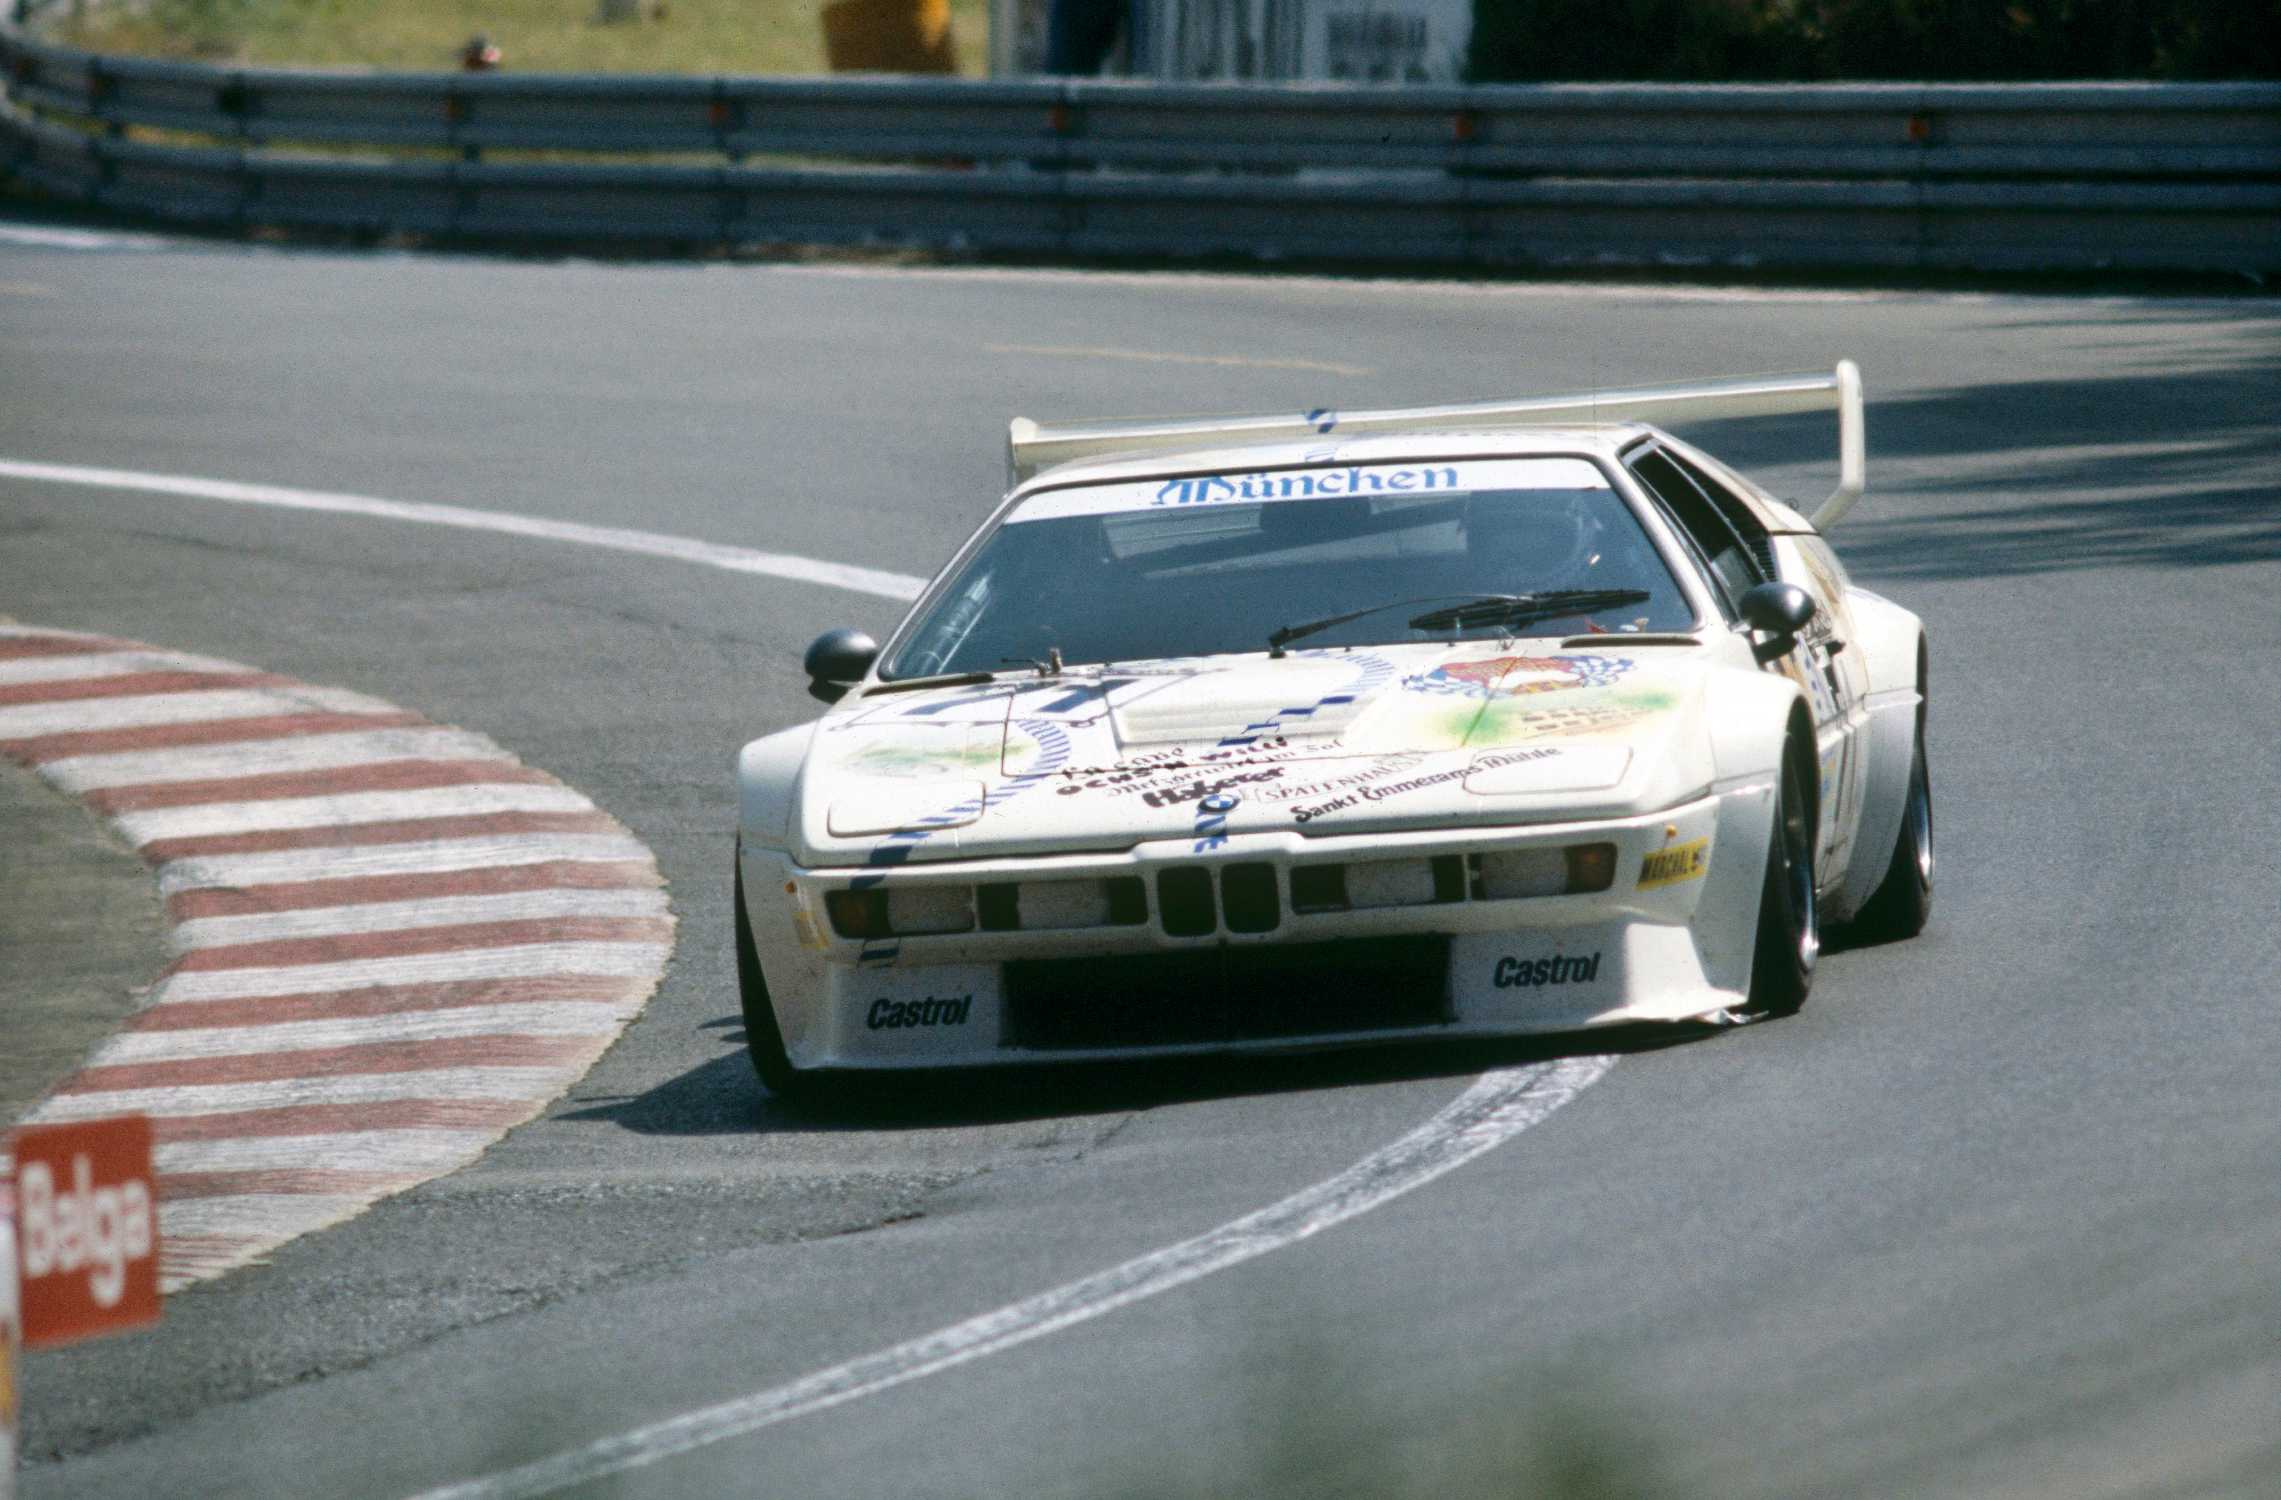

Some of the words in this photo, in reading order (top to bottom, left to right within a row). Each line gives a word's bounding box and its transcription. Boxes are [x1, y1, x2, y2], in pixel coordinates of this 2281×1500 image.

[1152, 465, 1458, 505] München
[1290, 793, 1359, 823] Sankt
[1493, 951, 1601, 989] Castrol
[866, 993, 973, 1031] Castrol
[21, 1151, 151, 1308] Belga
